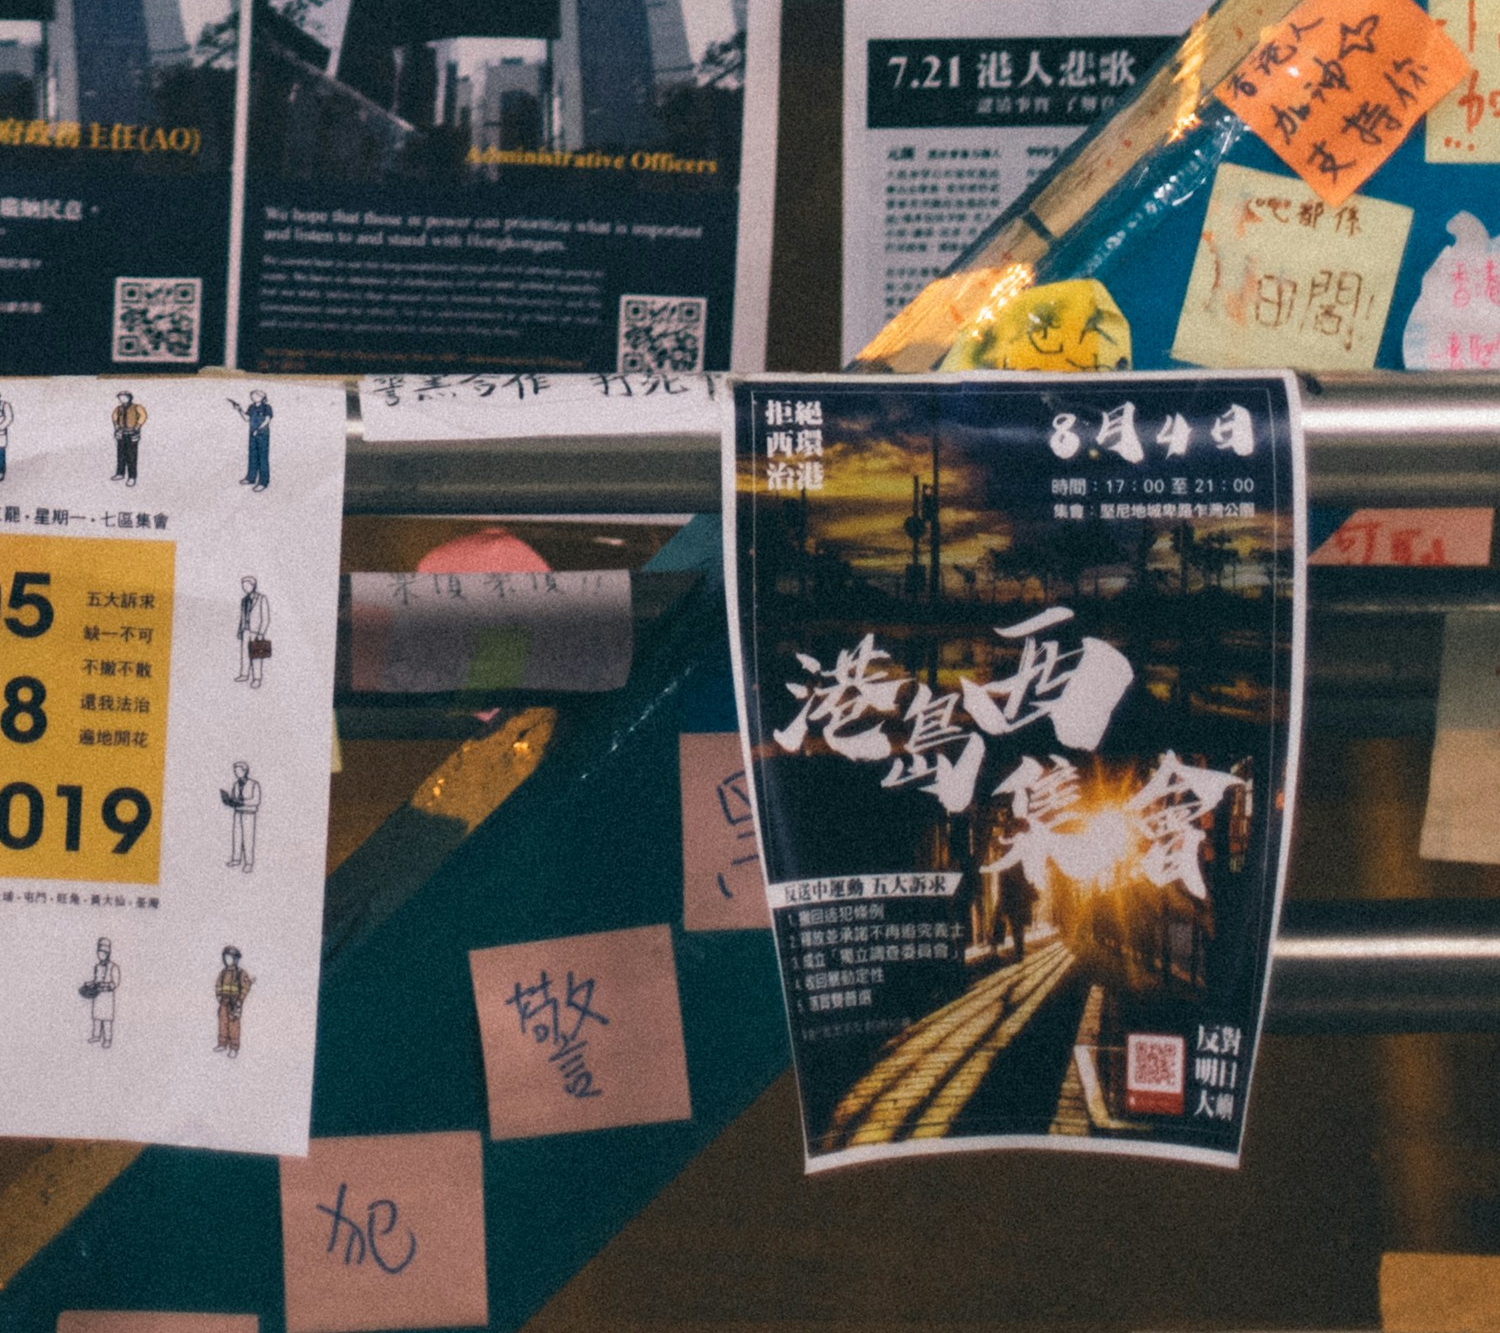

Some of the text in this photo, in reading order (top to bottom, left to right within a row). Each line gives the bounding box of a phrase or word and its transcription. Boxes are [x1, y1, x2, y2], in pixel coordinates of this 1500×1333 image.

[886, 51, 1139, 92] 7.21 港人悲歌
[465, 145, 719, 175] Administrative Officers
[1050, 403, 1257, 463] 8月4日
[86, 590, 156, 612] 五大訴求
[503, 969, 613, 1102] 警
